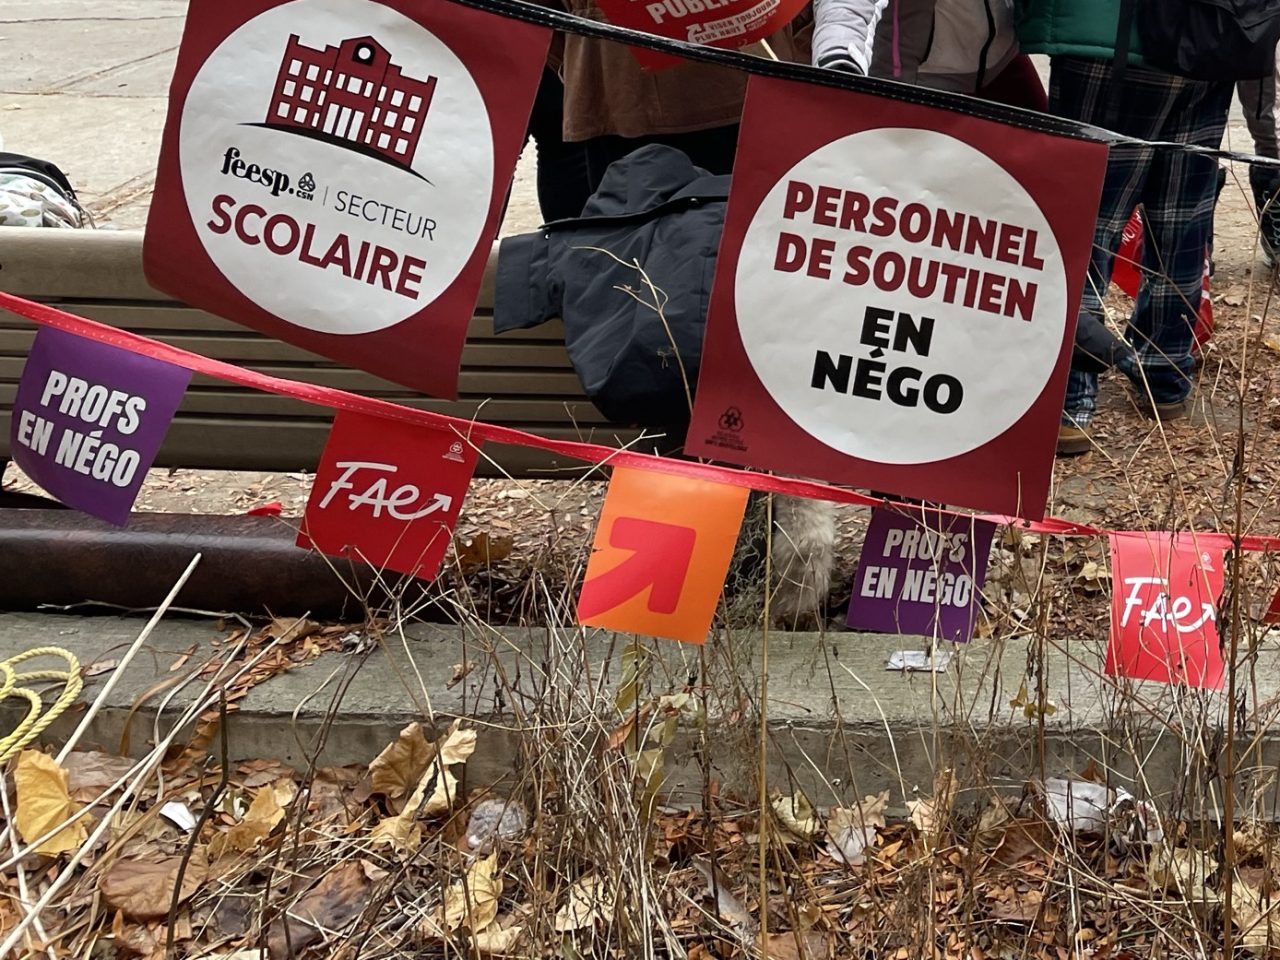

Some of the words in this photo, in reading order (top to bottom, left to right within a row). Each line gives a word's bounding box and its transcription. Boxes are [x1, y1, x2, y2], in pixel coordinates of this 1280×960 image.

[206, 194, 427, 300] SCOLAIRE
[334, 190, 437, 241] SECTEUR
[783, 180, 1045, 271] PERSONNEL
[774, 231, 836, 280] DE
[843, 245, 1038, 322] SOUTIEN
[860, 306, 935, 357] EN
[40, 370, 146, 435] PROFS
[811, 346, 964, 414] NÉGO
[17, 410, 54, 456] EN
[55, 429, 140, 487] NÉGO
[883, 529, 968, 563] PROFS
[860, 566, 898, 599] EN
[902, 564, 972, 608] NÉGO
